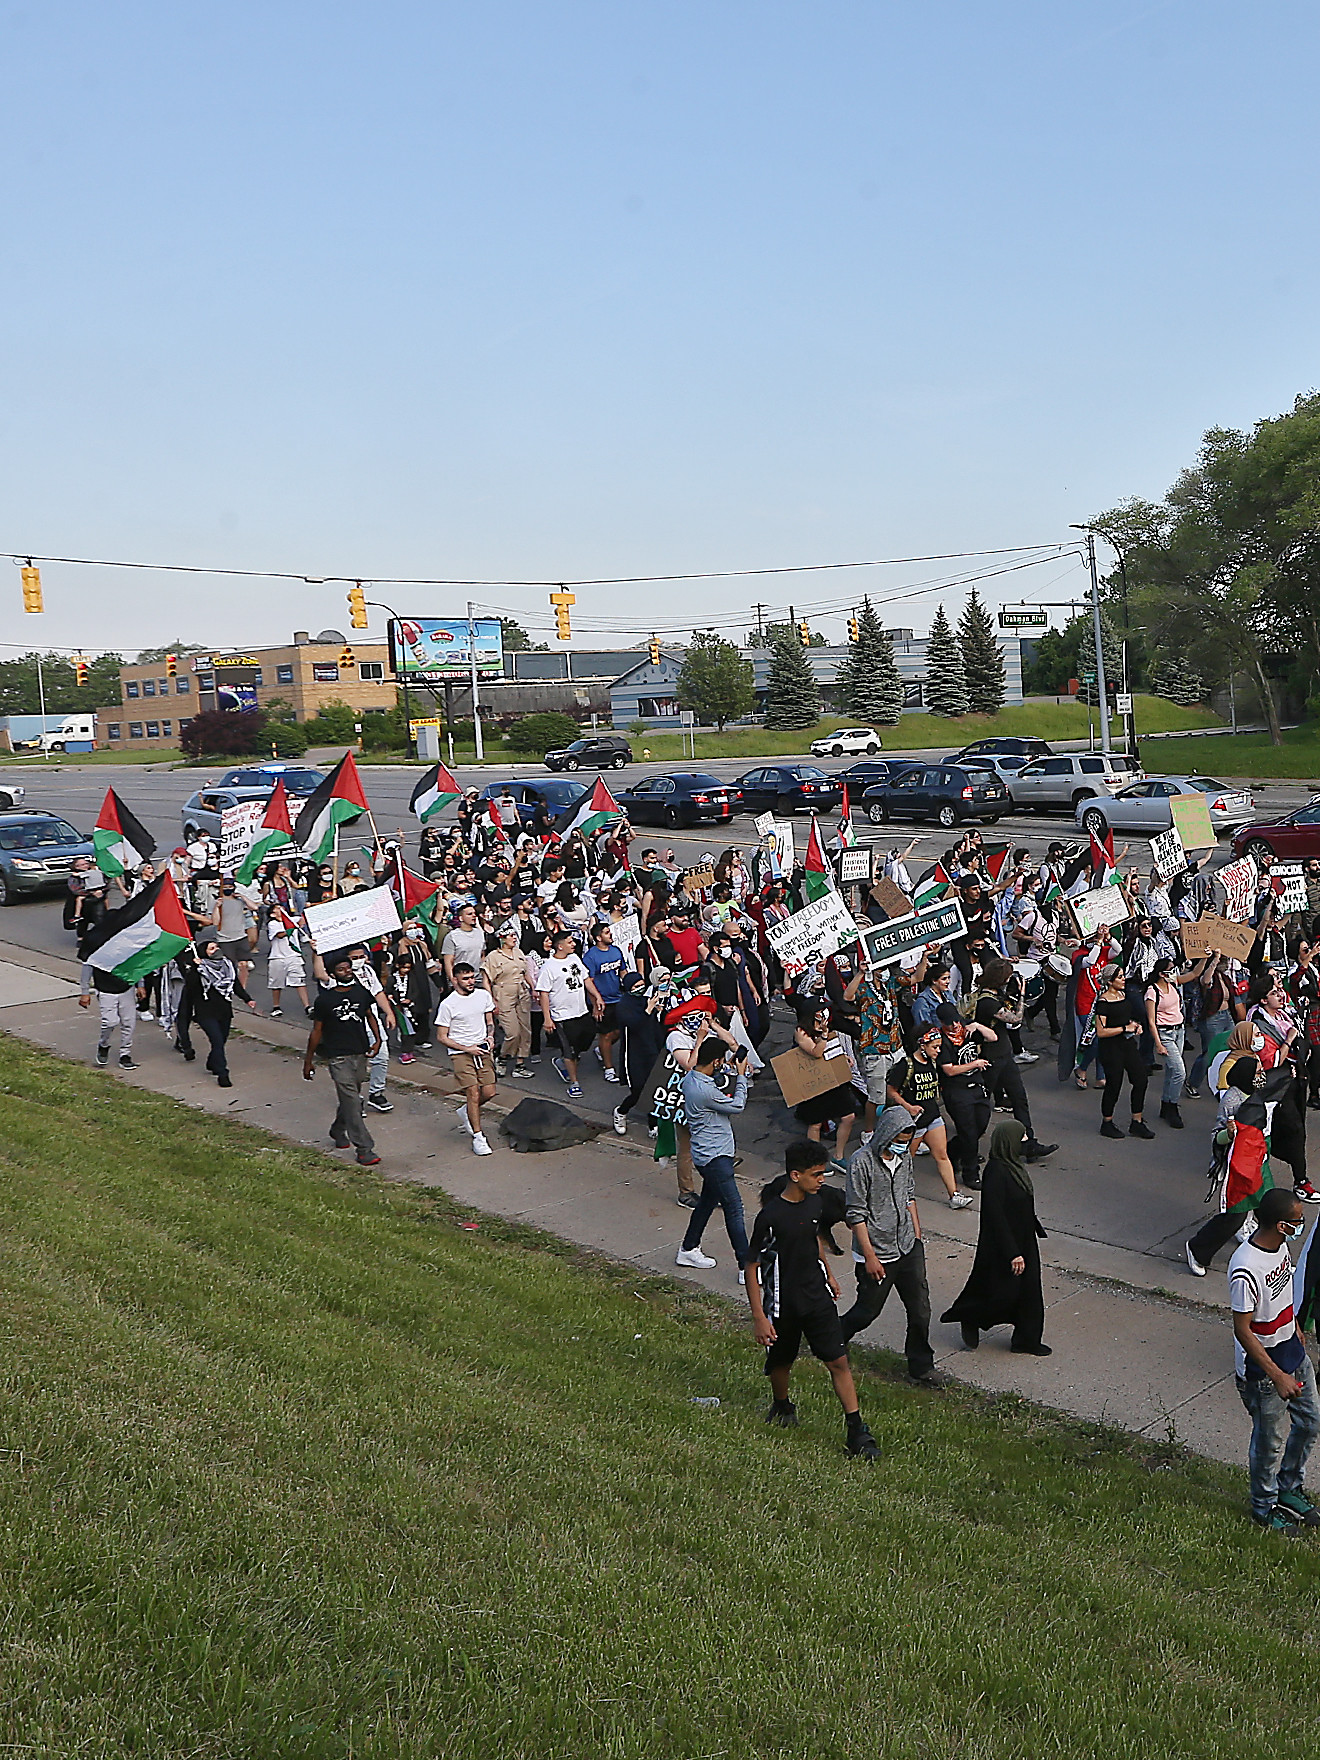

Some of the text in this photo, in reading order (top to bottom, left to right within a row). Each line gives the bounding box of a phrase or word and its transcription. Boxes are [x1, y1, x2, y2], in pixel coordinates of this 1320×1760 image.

[1005, 615, 1030, 623] Oakman
[212, 657, 241, 666] GALAXY
[221, 826, 246, 844] STOP
[1157, 843, 1182, 862] SILENCED
[1162, 854, 1179, 870] FREE
[1268, 864, 1304, 877] GENOCIDE
[1222, 862, 1254, 888] ARREST
[1286, 879, 1301, 891] NOT
[766, 895, 836, 941] YOUR FREEDOM
[874, 911, 958, 952] FREE PALESTINE NOW
[1187, 925, 1199, 935] FREE
[783, 922, 839, 958] THE FREEDOM OF
